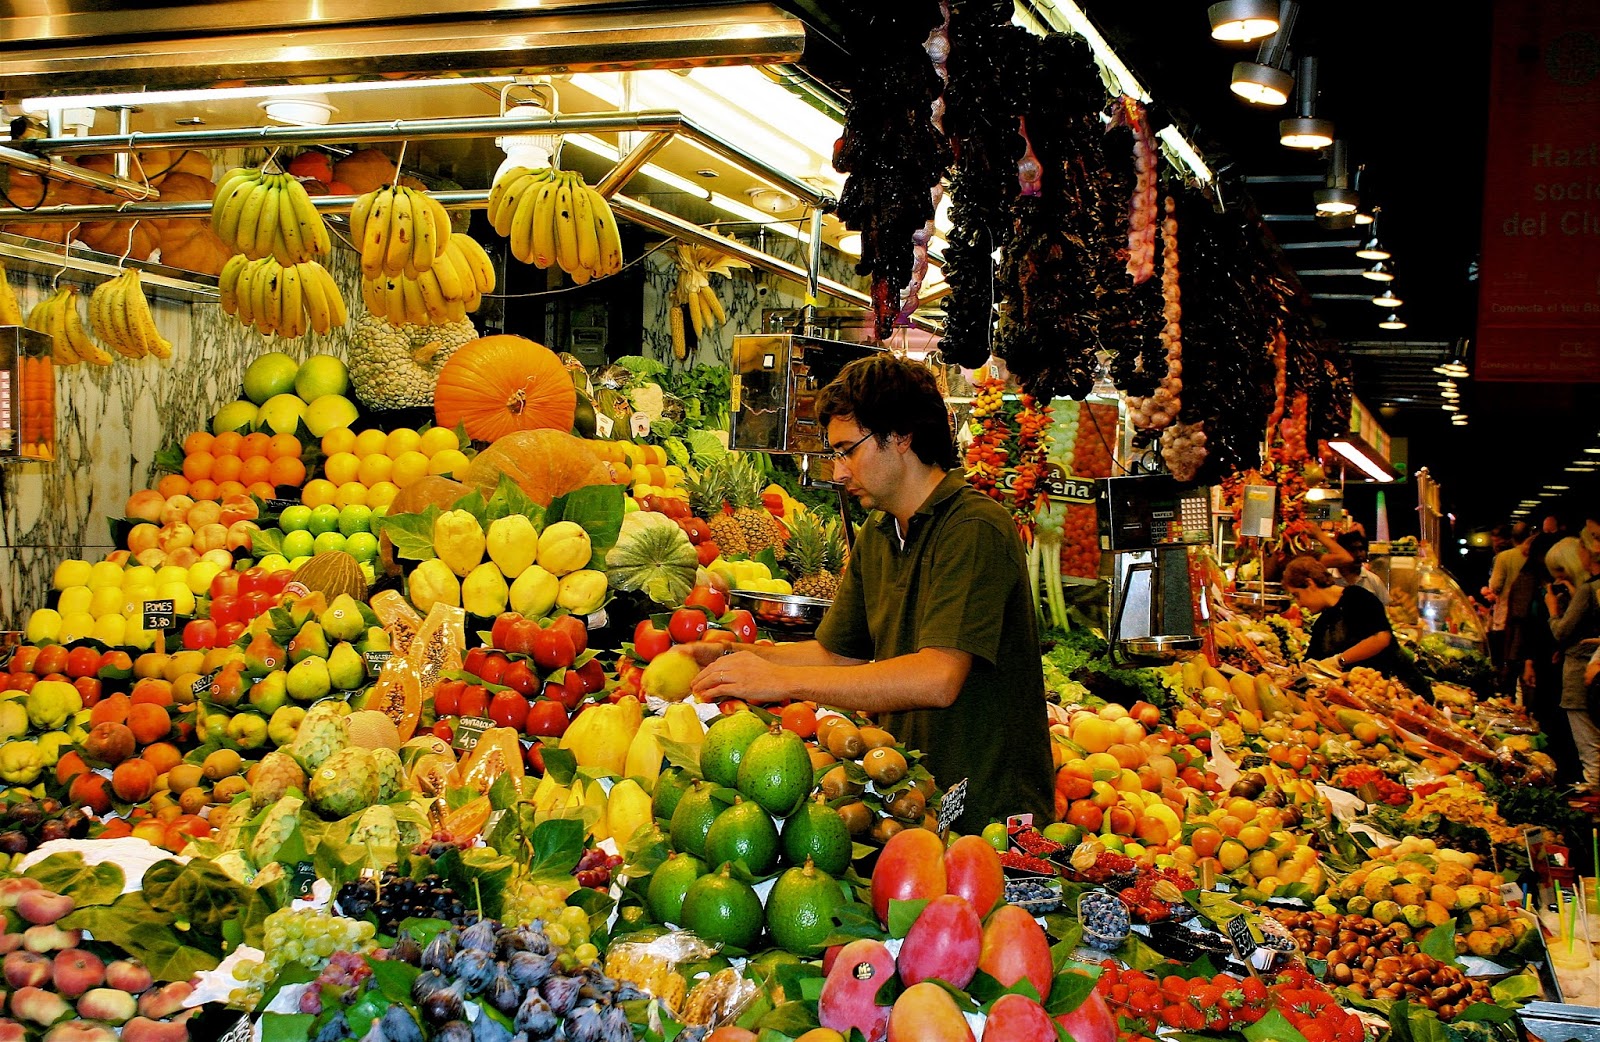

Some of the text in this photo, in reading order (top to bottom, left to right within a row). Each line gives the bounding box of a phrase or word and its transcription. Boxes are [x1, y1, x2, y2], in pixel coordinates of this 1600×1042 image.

[1503, 211, 1547, 236] del
[1004, 474, 1090, 498] Ceña
[145, 602, 172, 612] POMES
[301, 879, 311, 893] 6
